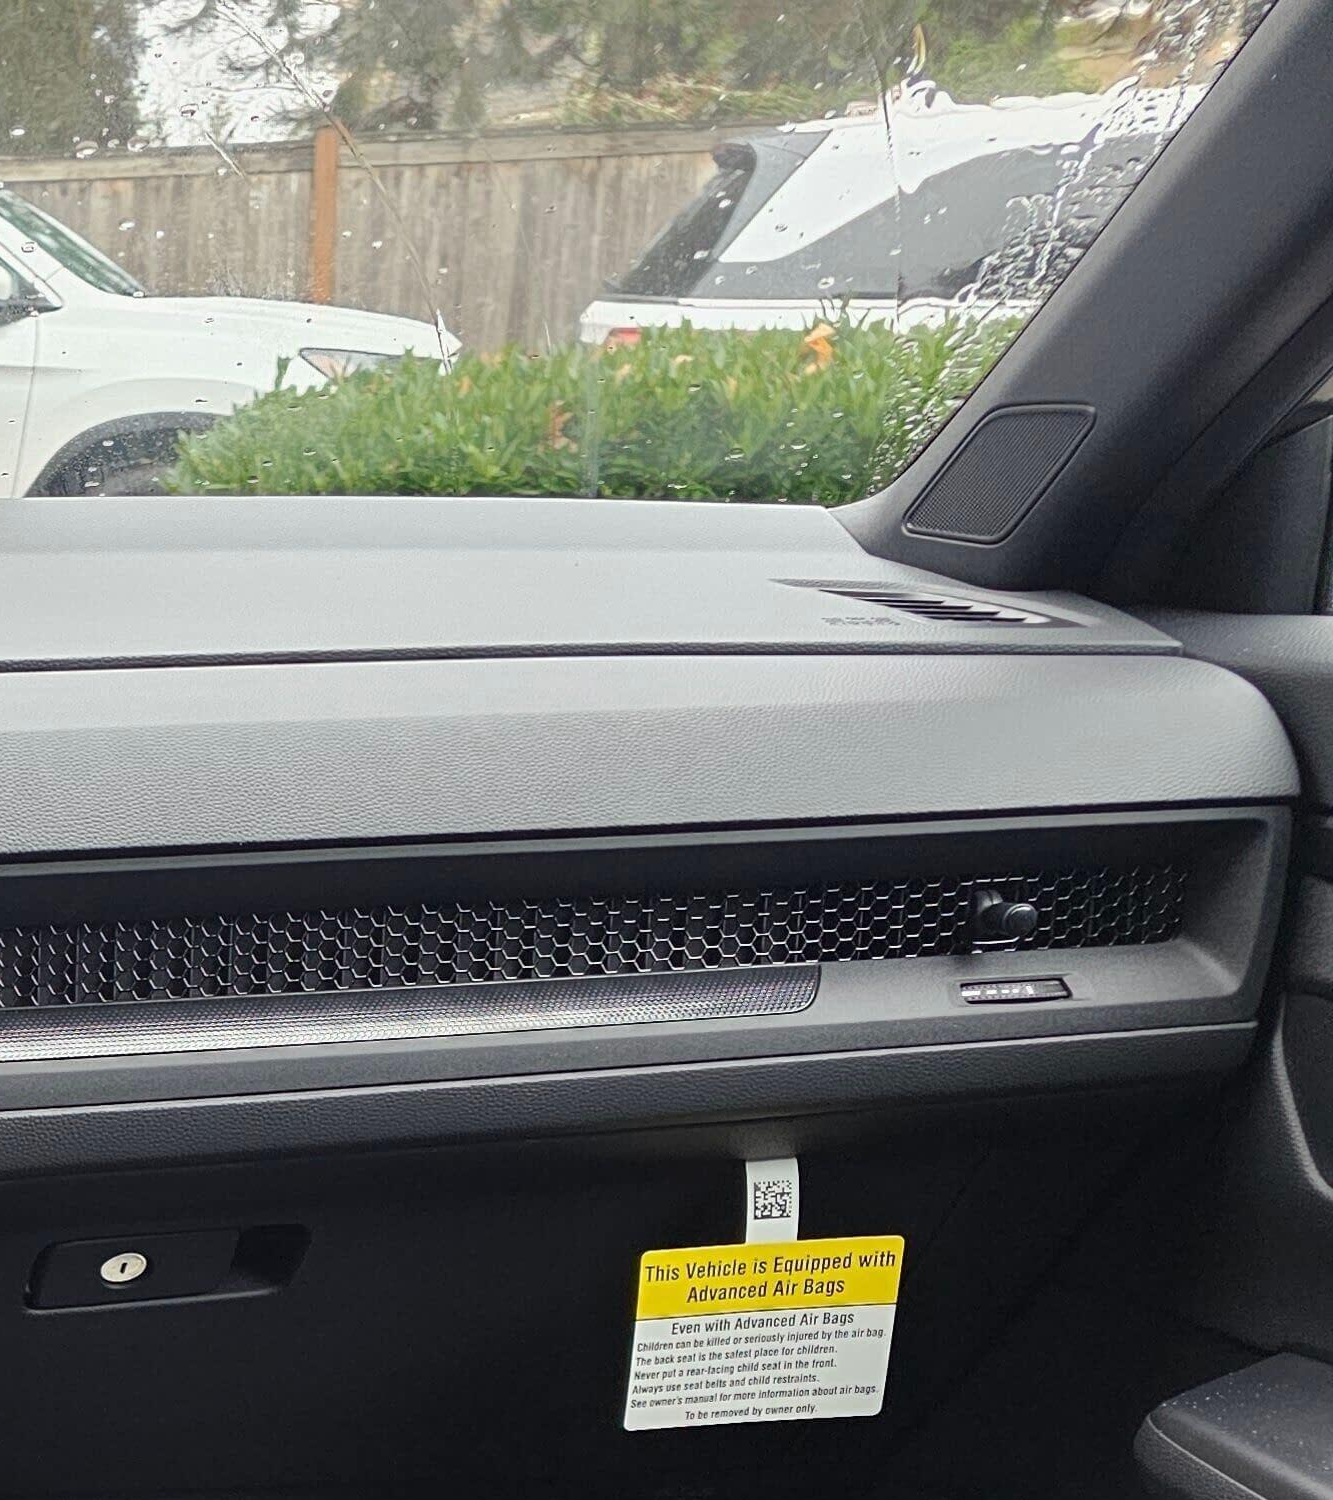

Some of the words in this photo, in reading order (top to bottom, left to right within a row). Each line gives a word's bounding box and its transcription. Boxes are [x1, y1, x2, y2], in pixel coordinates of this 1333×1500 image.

[645, 1265, 680, 1282] This
[686, 1259, 746, 1279] Vehicle
[754, 1258, 767, 1274] is
[774, 1252, 852, 1275] Equipped
[859, 1250, 896, 1267] with
[686, 1281, 767, 1303] Advanced
[773, 1280, 798, 1296] Air
[804, 1278, 845, 1296] Bags
[672, 1322, 700, 1335] Even
[705, 1319, 730, 1332] with
[734, 1314, 796, 1330] Advanced
[800, 1313, 819, 1326] Air
[823, 1312, 854, 1326] Bags
[637, 1341, 673, 1352] Children
[676, 1341, 691, 1349] can
[694, 1339, 704, 1348] be
[706, 1337, 730, 1347] killed
[744, 1333, 785, 1343] seriously
[787, 1331, 819, 1342] injured
[821, 1331, 832, 1341] by
[835, 1330, 848, 1339] the
[852, 1329, 864, 1337] air
[636, 1357, 651, 1366] The
[654, 1355, 674, 1365] back
[677, 1353, 696, 1363] seat
[698, 1353, 706, 1361] is
[709, 1351, 722, 1360] the
[725, 1349, 752, 1360] safest
[754, 1348, 779, 1359] place
[781, 1347, 794, 1356] for
[797, 1344, 837, 1355] children.
[634, 1371, 660, 1380] Never
[662, 1369, 676, 1379] put
[686, 1365, 734, 1377] rear-facing
[737, 1362, 759, 1373] child
[761, 1361, 781, 1371] seat
[783, 1361, 793, 1370] in
[795, 1359, 809, 1369] the
[812, 1358, 837, 1368] front.
[632, 1385, 663, 1395] Always
[666, 1384, 681, 1392] use
[684, 1382, 703, 1391] seat
[705, 1379, 727, 1389] belts
[729, 1377, 745, 1387] and
[748, 1376, 770, 1386] child
[773, 1374, 820, 1384] restraints.
[630, 1400, 647, 1409] See
[649, 1396, 683, 1407] owner's
[685, 1393, 718, 1404] manual
[720, 1392, 731, 1402] for
[733, 1392, 756, 1401] more
[758, 1389, 810, 1399] information
[812, 1386, 838, 1396] about
[839, 1385, 852, 1394] air
[685, 1411, 695, 1420] To
[698, 1410, 708, 1419] be
[711, 1407, 749, 1418] removed
[752, 1407, 762, 1416] by
[765, 1406, 793, 1415] owner
